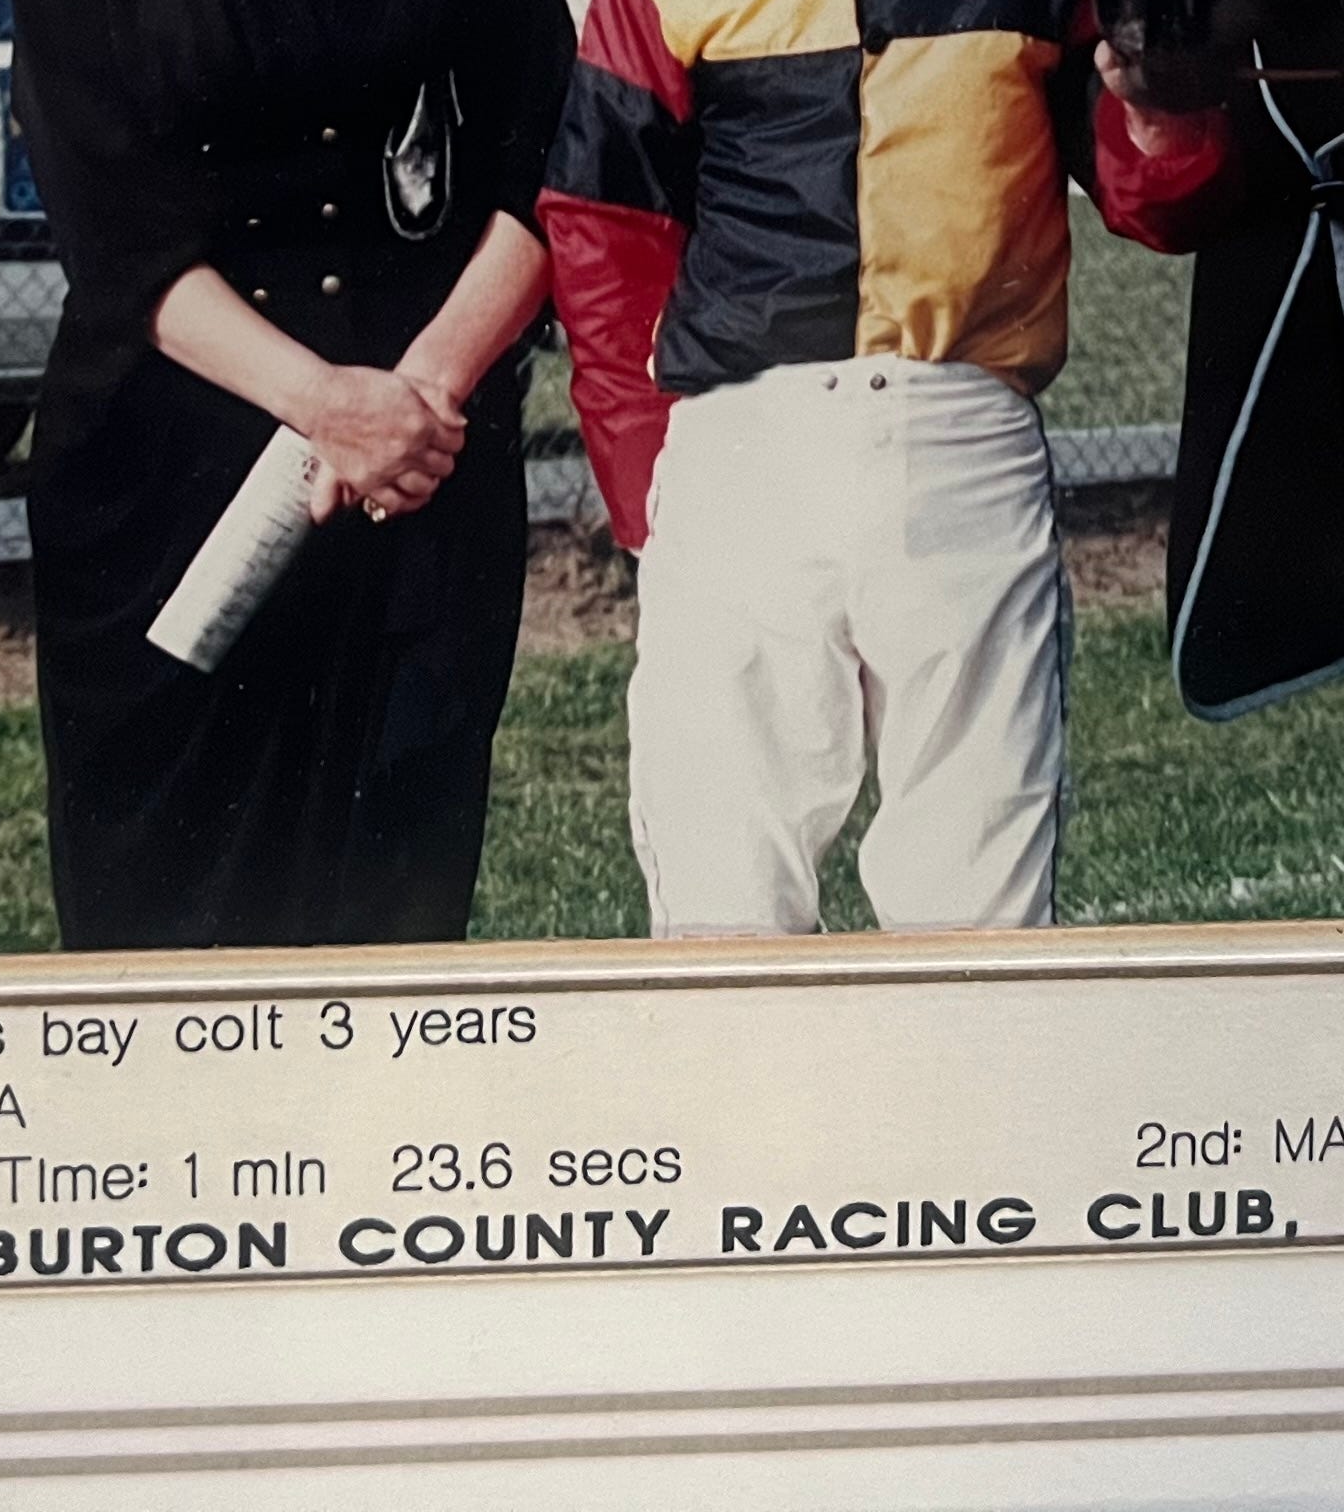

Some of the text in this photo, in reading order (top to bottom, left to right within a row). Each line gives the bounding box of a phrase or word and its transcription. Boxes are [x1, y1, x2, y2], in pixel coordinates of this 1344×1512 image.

[42, 1011, 138, 1067] bay
[175, 1003, 284, 1053] colt
[320, 1000, 354, 1050] 3
[389, 1006, 537, 1059] years
[184, 1151, 198, 1199] 1
[391, 1142, 513, 1193] 23.6
[548, 1146, 682, 1188] secs
[1136, 1120, 1242, 1168] 2nd:
[338, 1208, 671, 1267] COUNTY
[721, 1197, 1037, 1254] RACING
[1086, 1189, 1298, 1241] CLUB,
